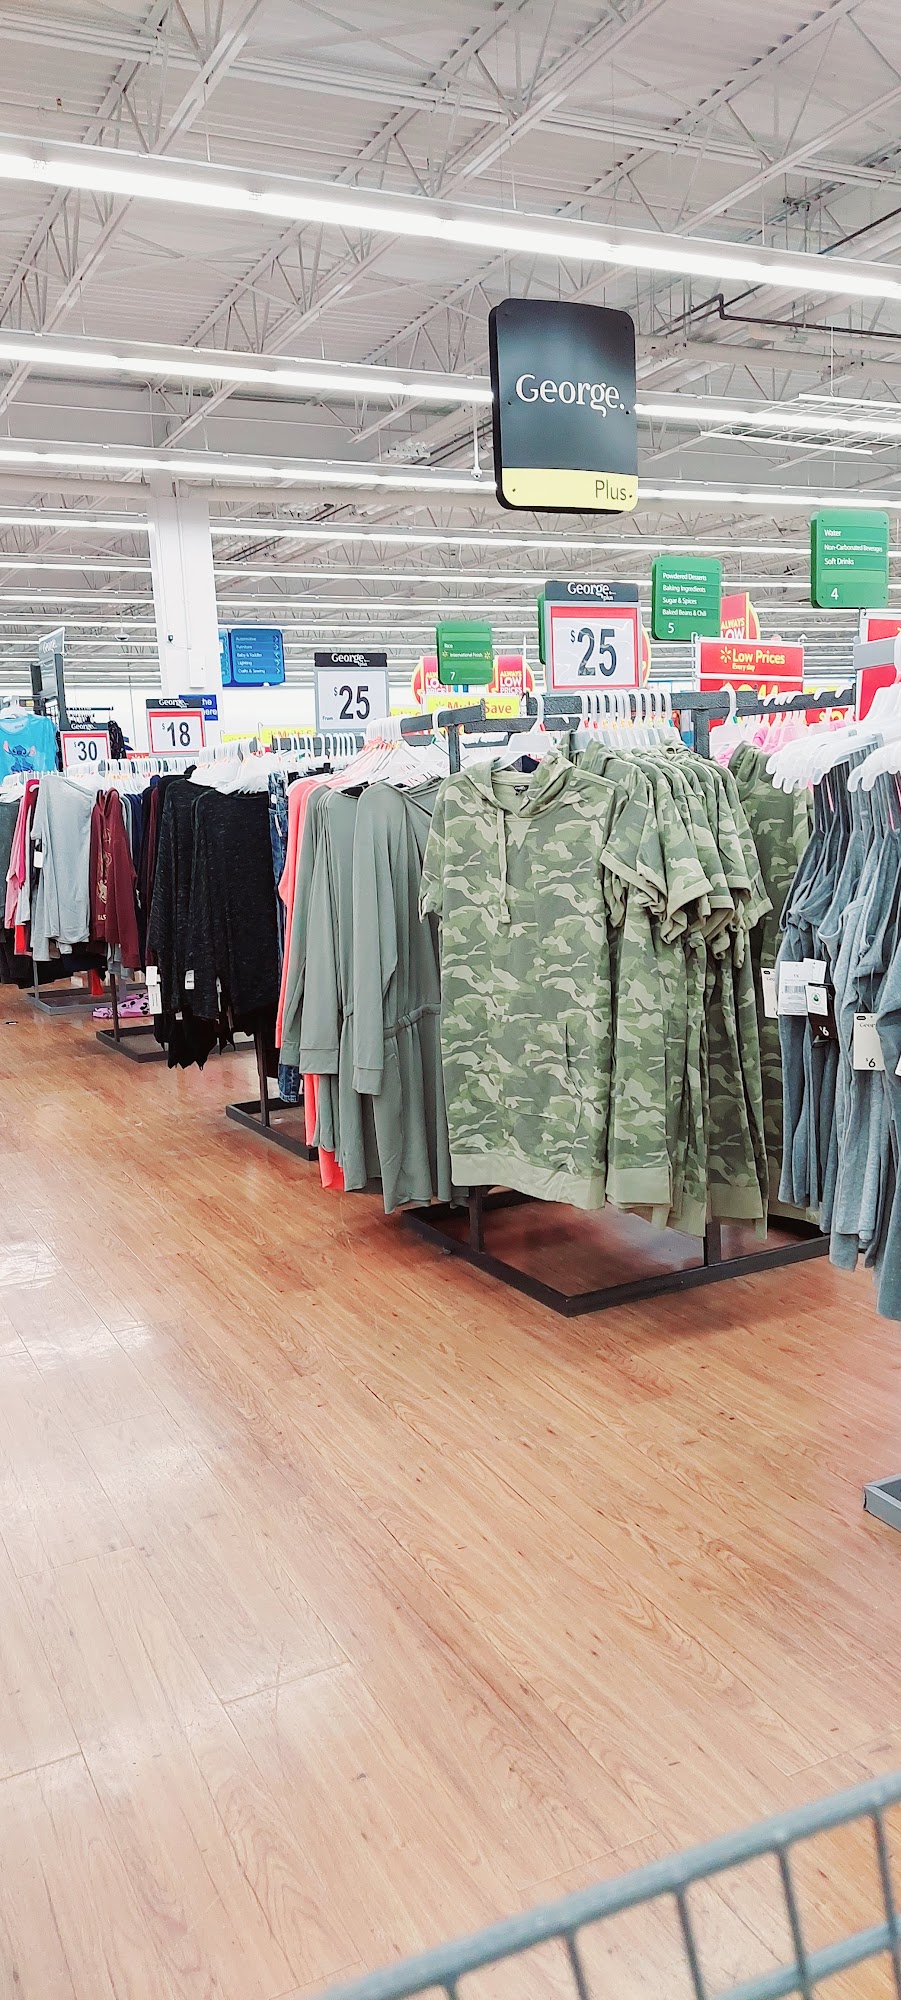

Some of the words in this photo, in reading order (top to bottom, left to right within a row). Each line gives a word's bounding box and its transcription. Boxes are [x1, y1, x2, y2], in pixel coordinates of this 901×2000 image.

[515, 374, 625, 418] George.
[595, 479, 627, 501] Plus
[824, 529, 842, 537] Water
[662, 584, 680, 593] Baking
[681, 585, 706, 593] Ingredients
[830, 587, 839, 600] 4
[662, 597, 677, 605] Sugar
[667, 622, 675, 634] 5
[721, 617, 745, 629] ALWAYS
[570, 627, 617, 677] $25
[732, 648, 754, 663] Low
[756, 649, 786, 665] Prices
[732, 663, 746, 671] Every
[746, 664, 755, 672] day
[450, 671, 456, 680] 7
[500, 676, 522, 687] LOW
[426, 677, 440, 688] LO
[333, 685, 371, 720] $25
[162, 721, 191, 747] $18
[73, 740, 98, 761] $30
